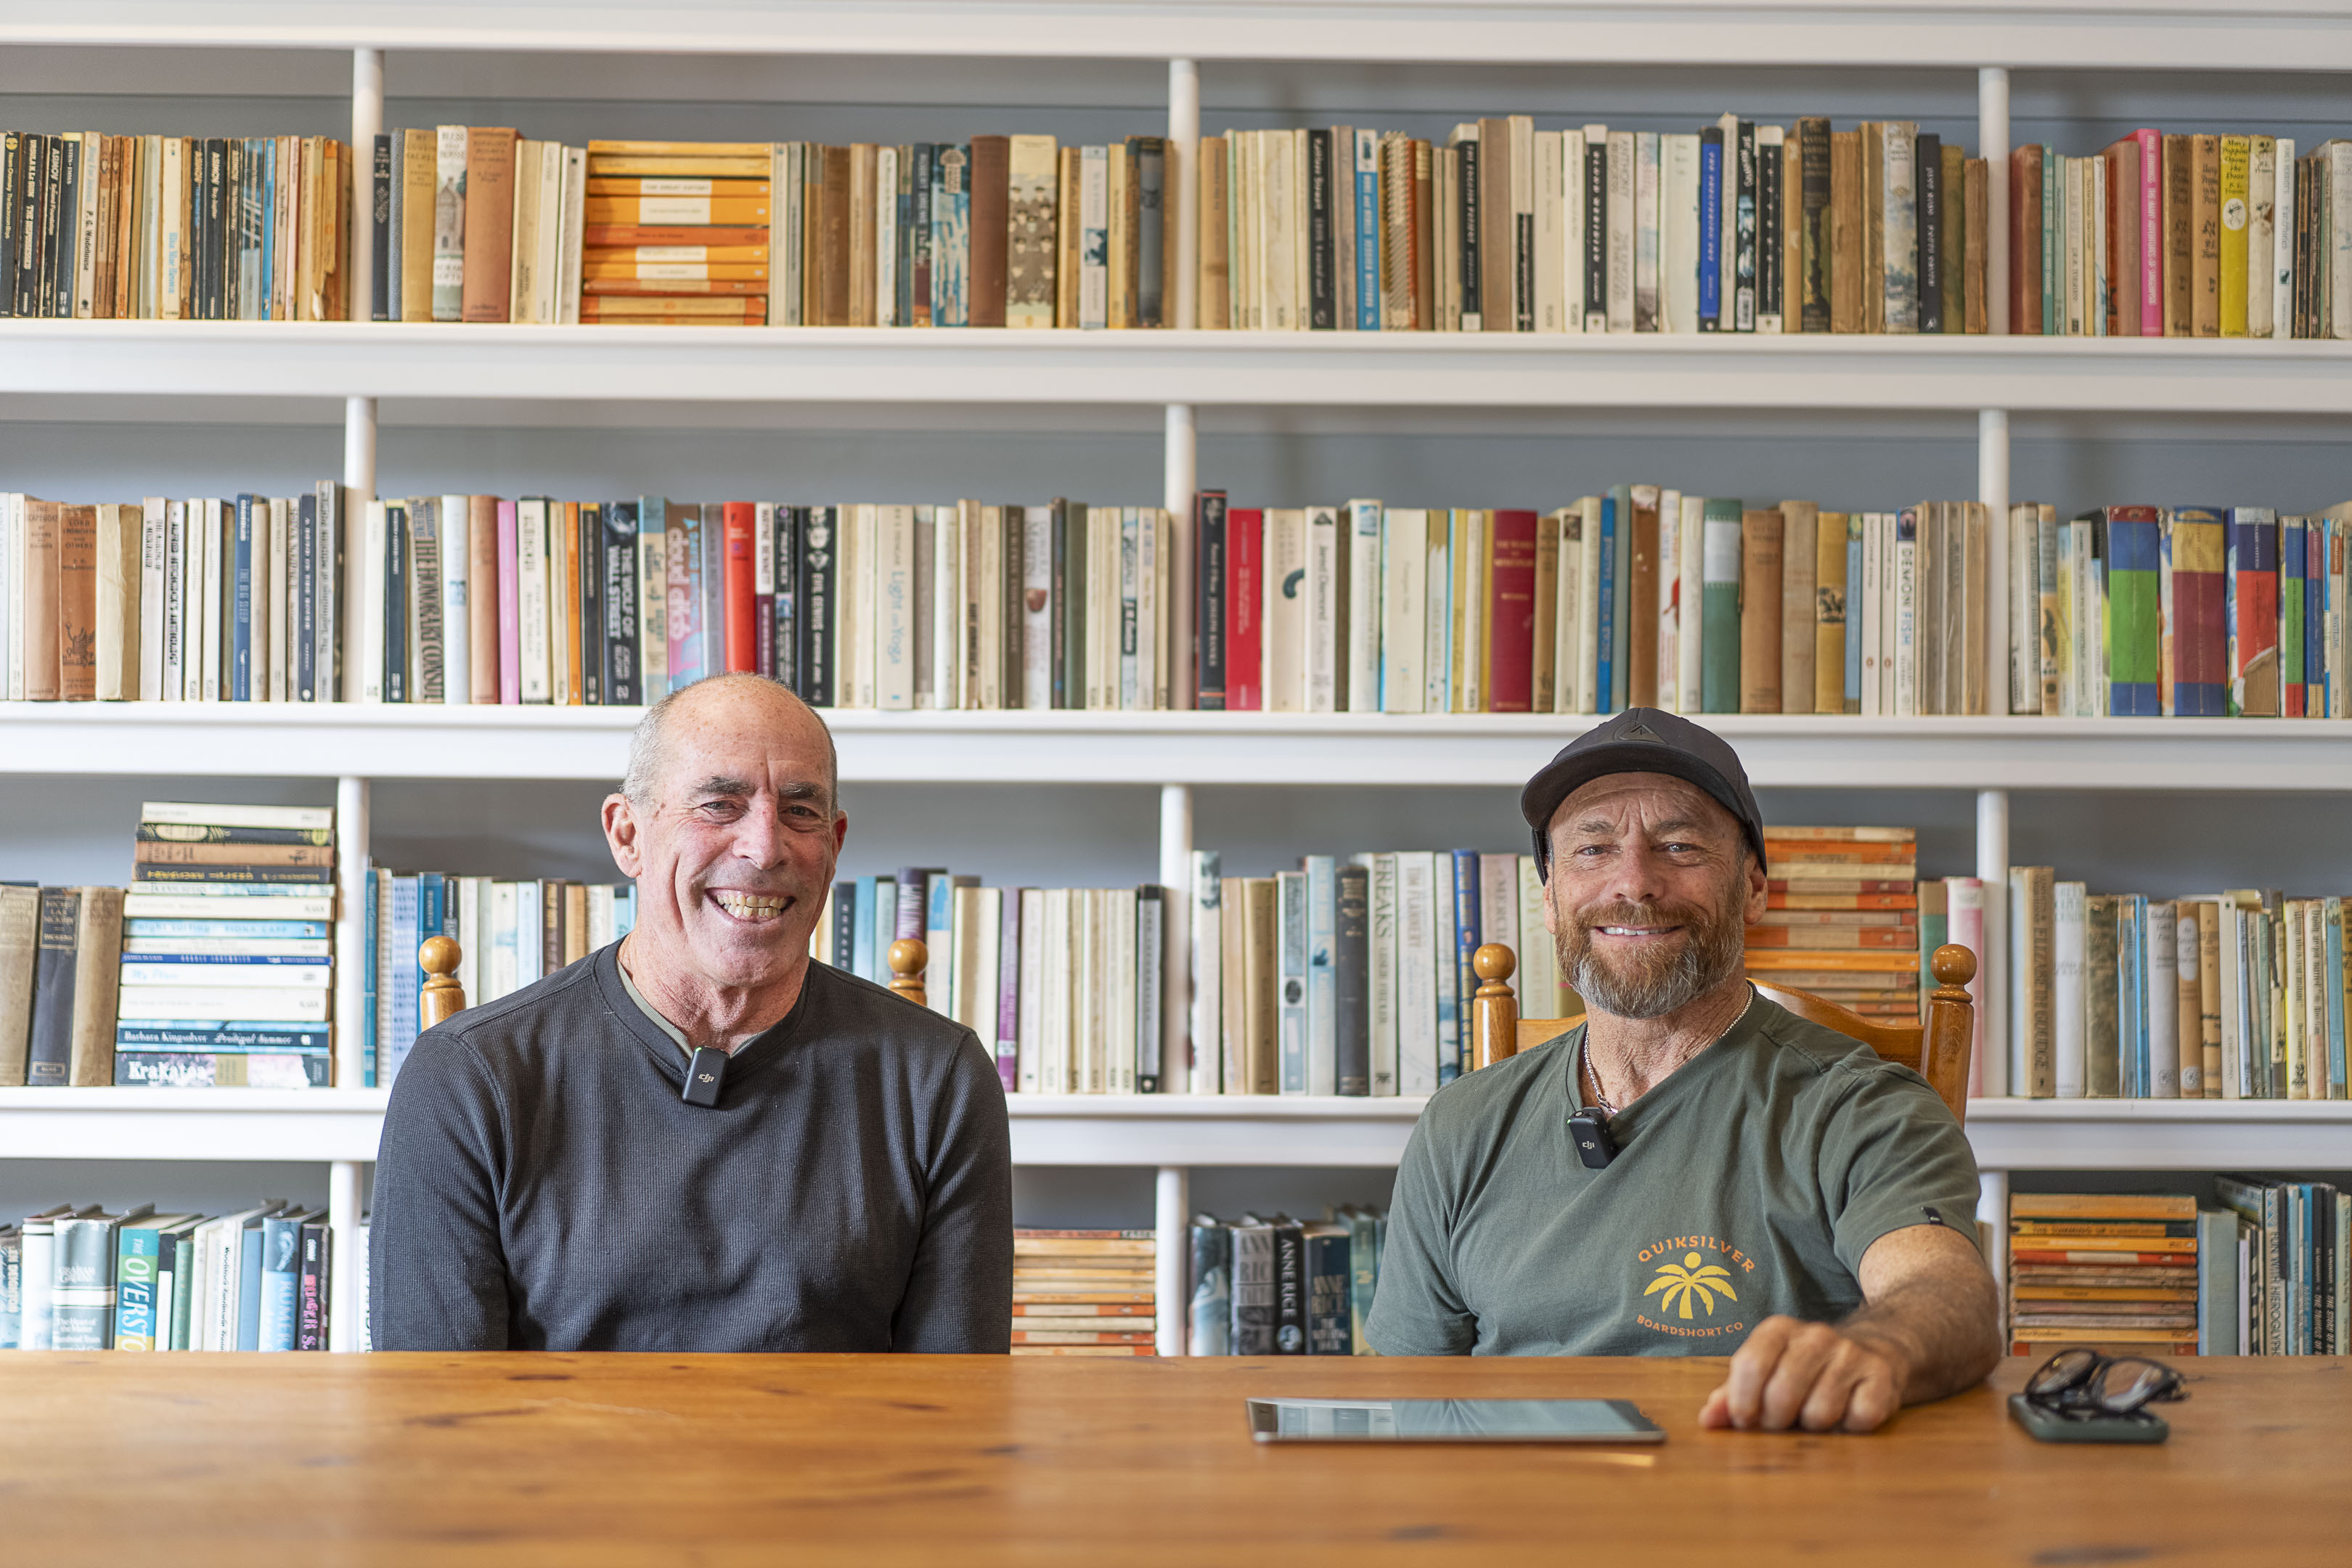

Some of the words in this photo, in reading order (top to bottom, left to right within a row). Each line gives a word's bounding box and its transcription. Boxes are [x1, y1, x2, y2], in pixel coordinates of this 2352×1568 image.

[52, 148, 60, 181] ASIMOV
[211, 151, 220, 184] ASIMOV
[171, 521, 179, 553] ALFRED
[761, 509, 771, 540] WAYNE
[415, 539, 437, 565] THE
[608, 545, 621, 583] WALL
[622, 547, 634, 573] THE
[761, 545, 771, 586] BENNETT
[170, 555, 179, 611] HITCHCOCK'S
[622, 575, 634, 613] WOLF
[812, 572, 823, 593] EVIL
[887, 570, 905, 611] Light
[417, 567, 442, 645] HONORARY
[608, 586, 621, 640] STREET
[812, 595, 823, 631] GENIUS
[622, 616, 634, 638] OF
[887, 626, 905, 665] Yoga
[1375, 859, 1393, 938] FREAKS
[1406, 891, 1421, 947] FLANNERY
[1378, 947, 1388, 979] LESLIE
[2033, 927, 2048, 1009] ELIZABETH
[124, 1030, 159, 1042] Barbara
[161, 1031, 208, 1044] Kingsolver
[2035, 1010, 2049, 1071] GOUDGE
[132, 1238, 144, 1255] THE
[1282, 1238, 1297, 1281] ANNE
[1638, 1235, 1755, 1273] QUIKSILVER
[2270, 1231, 2281, 1254] FUN
[2270, 1257, 2281, 1284] WITH
[121, 1257, 150, 1351] OVERSTO
[278, 1281, 294, 1345] RUMER
[1282, 1282, 1297, 1318] RICE
[1311, 1294, 1346, 1314] RICE
[1637, 1315, 1722, 1337] BOARDSHORT
[1725, 1321, 1743, 1334] CO
[2270, 1286, 2282, 1355] HIEROGLYPH
